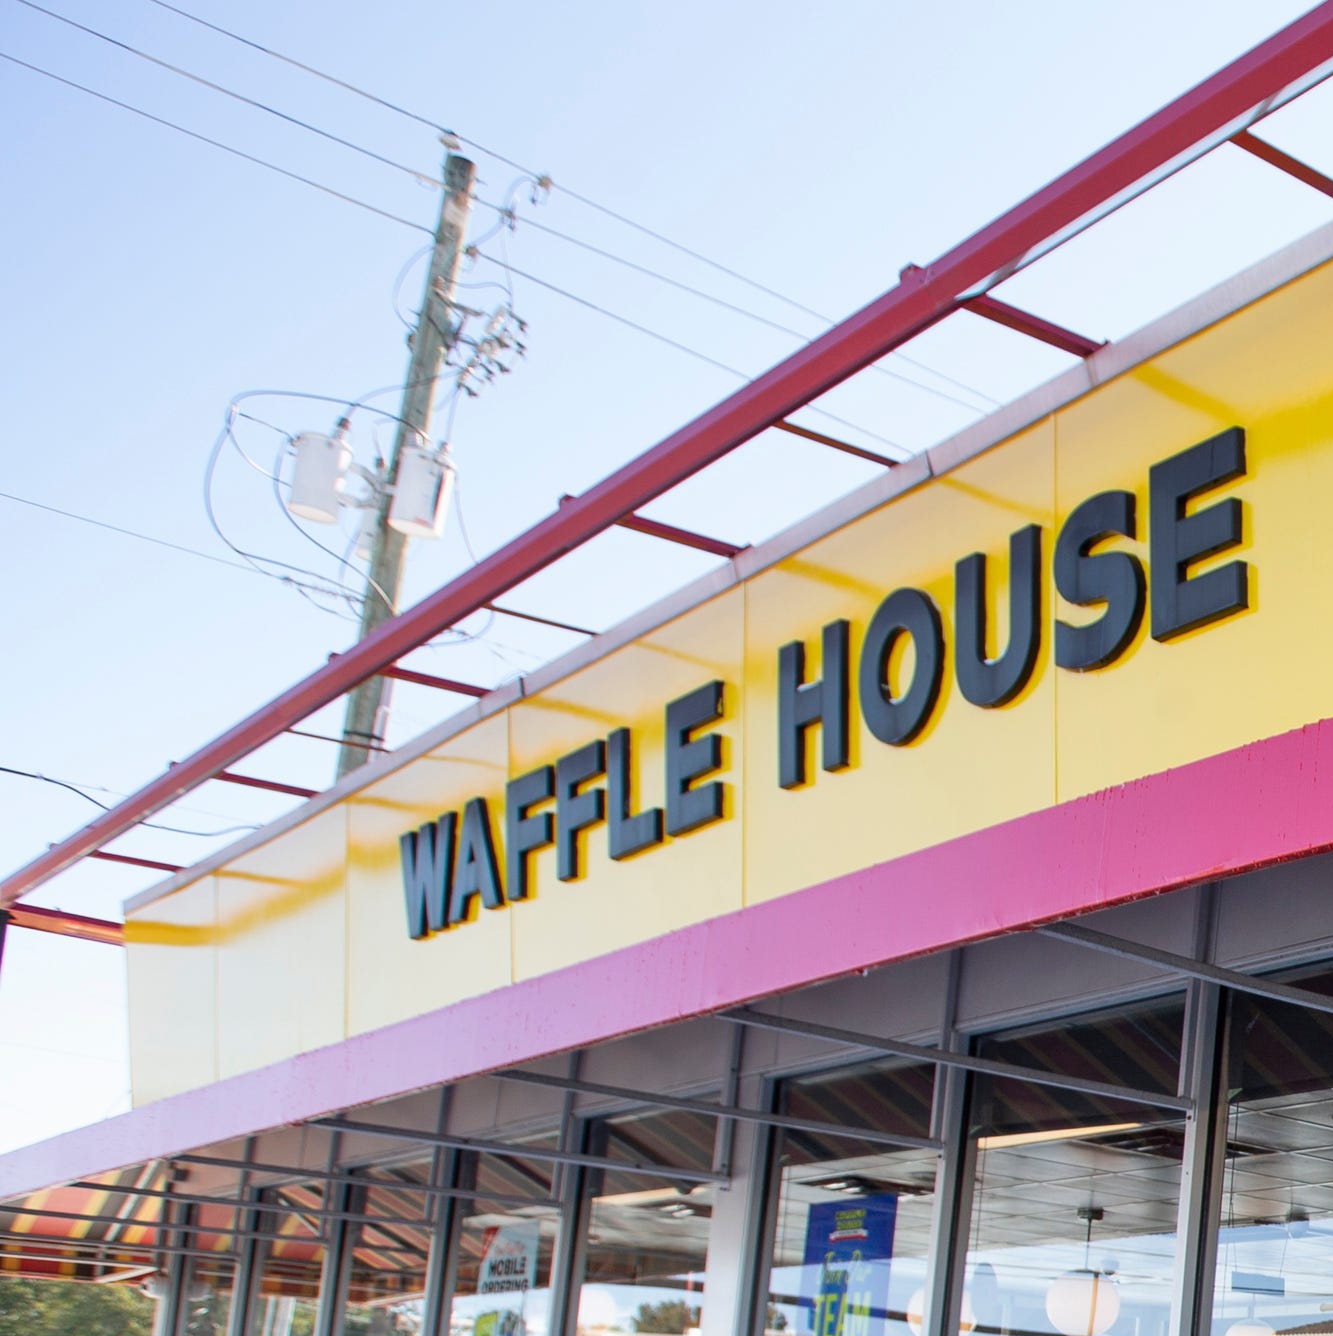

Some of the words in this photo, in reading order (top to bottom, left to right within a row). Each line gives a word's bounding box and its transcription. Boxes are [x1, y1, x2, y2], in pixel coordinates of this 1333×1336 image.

[399, 679, 725, 940] WAFFLE
[777, 426, 1250, 790] HOUSE
[487, 1256, 527, 1276] MOBILE
